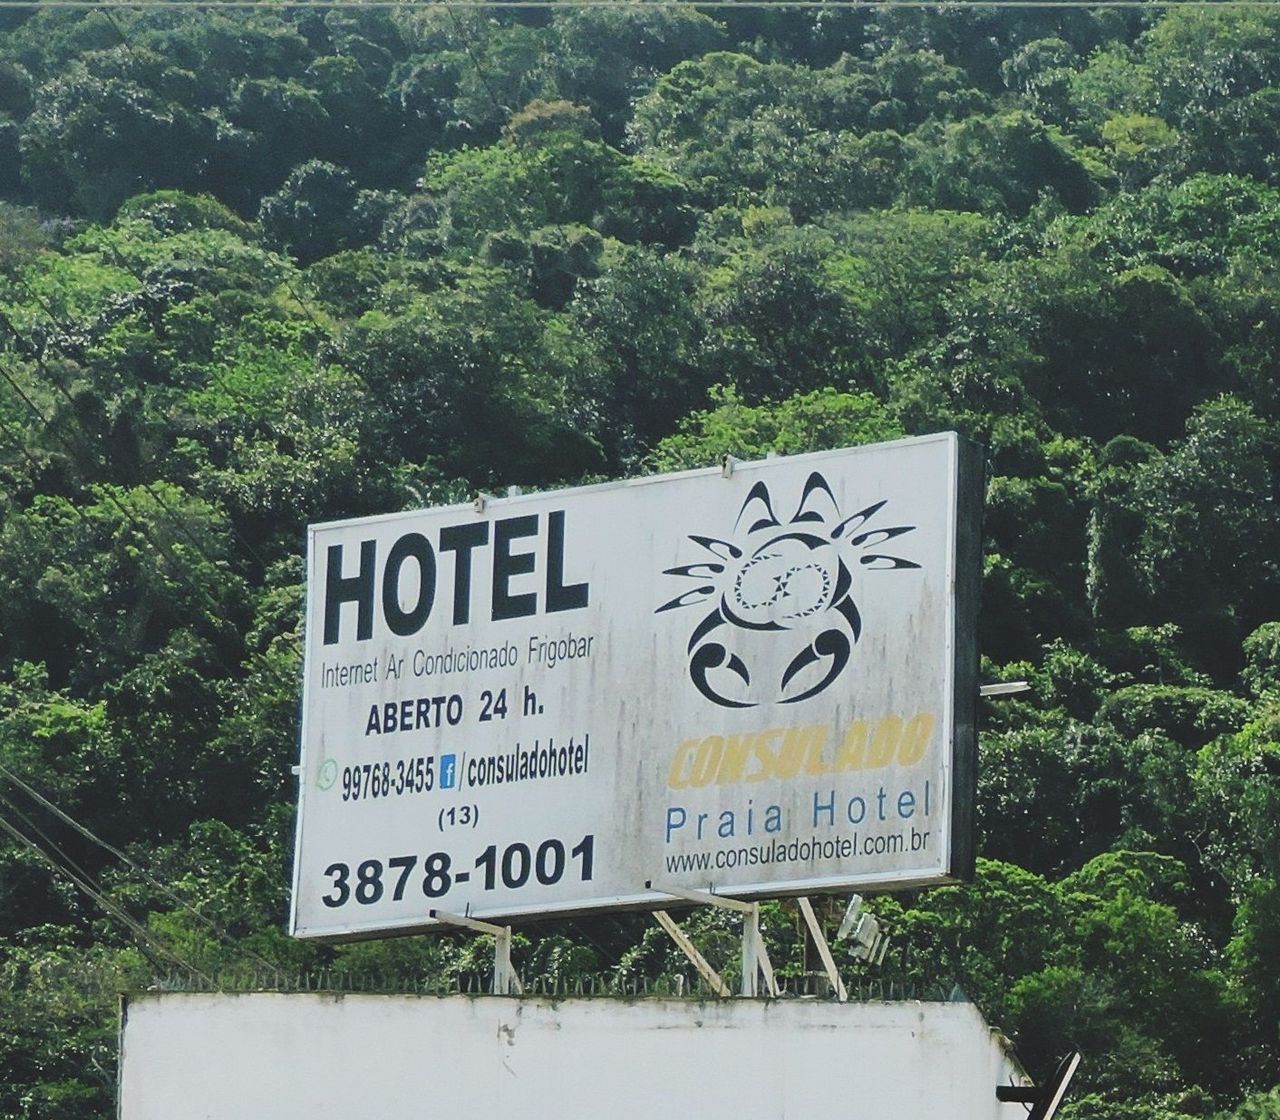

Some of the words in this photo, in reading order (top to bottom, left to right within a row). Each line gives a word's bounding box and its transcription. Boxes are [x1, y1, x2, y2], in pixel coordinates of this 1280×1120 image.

[323, 509, 589, 646] HOTEL
[321, 654, 378, 688] Internet
[385, 653, 404, 680] Ar
[413, 640, 518, 677] Condicionado
[528, 632, 594, 669] Frigobar
[365, 694, 463, 736] ABERTO
[479, 688, 508, 722] 24
[523, 685, 544, 716] h.
[342, 756, 434, 801] 99768-3455
[668, 712, 934, 791] CONSULADO
[438, 805, 479, 831] (13)
[666, 799, 782, 843] Praia
[813, 780, 930, 828] Hotel
[321, 834, 594, 908] 3878-1001
[666, 827, 930, 873] www.consuladohotel.com.br
